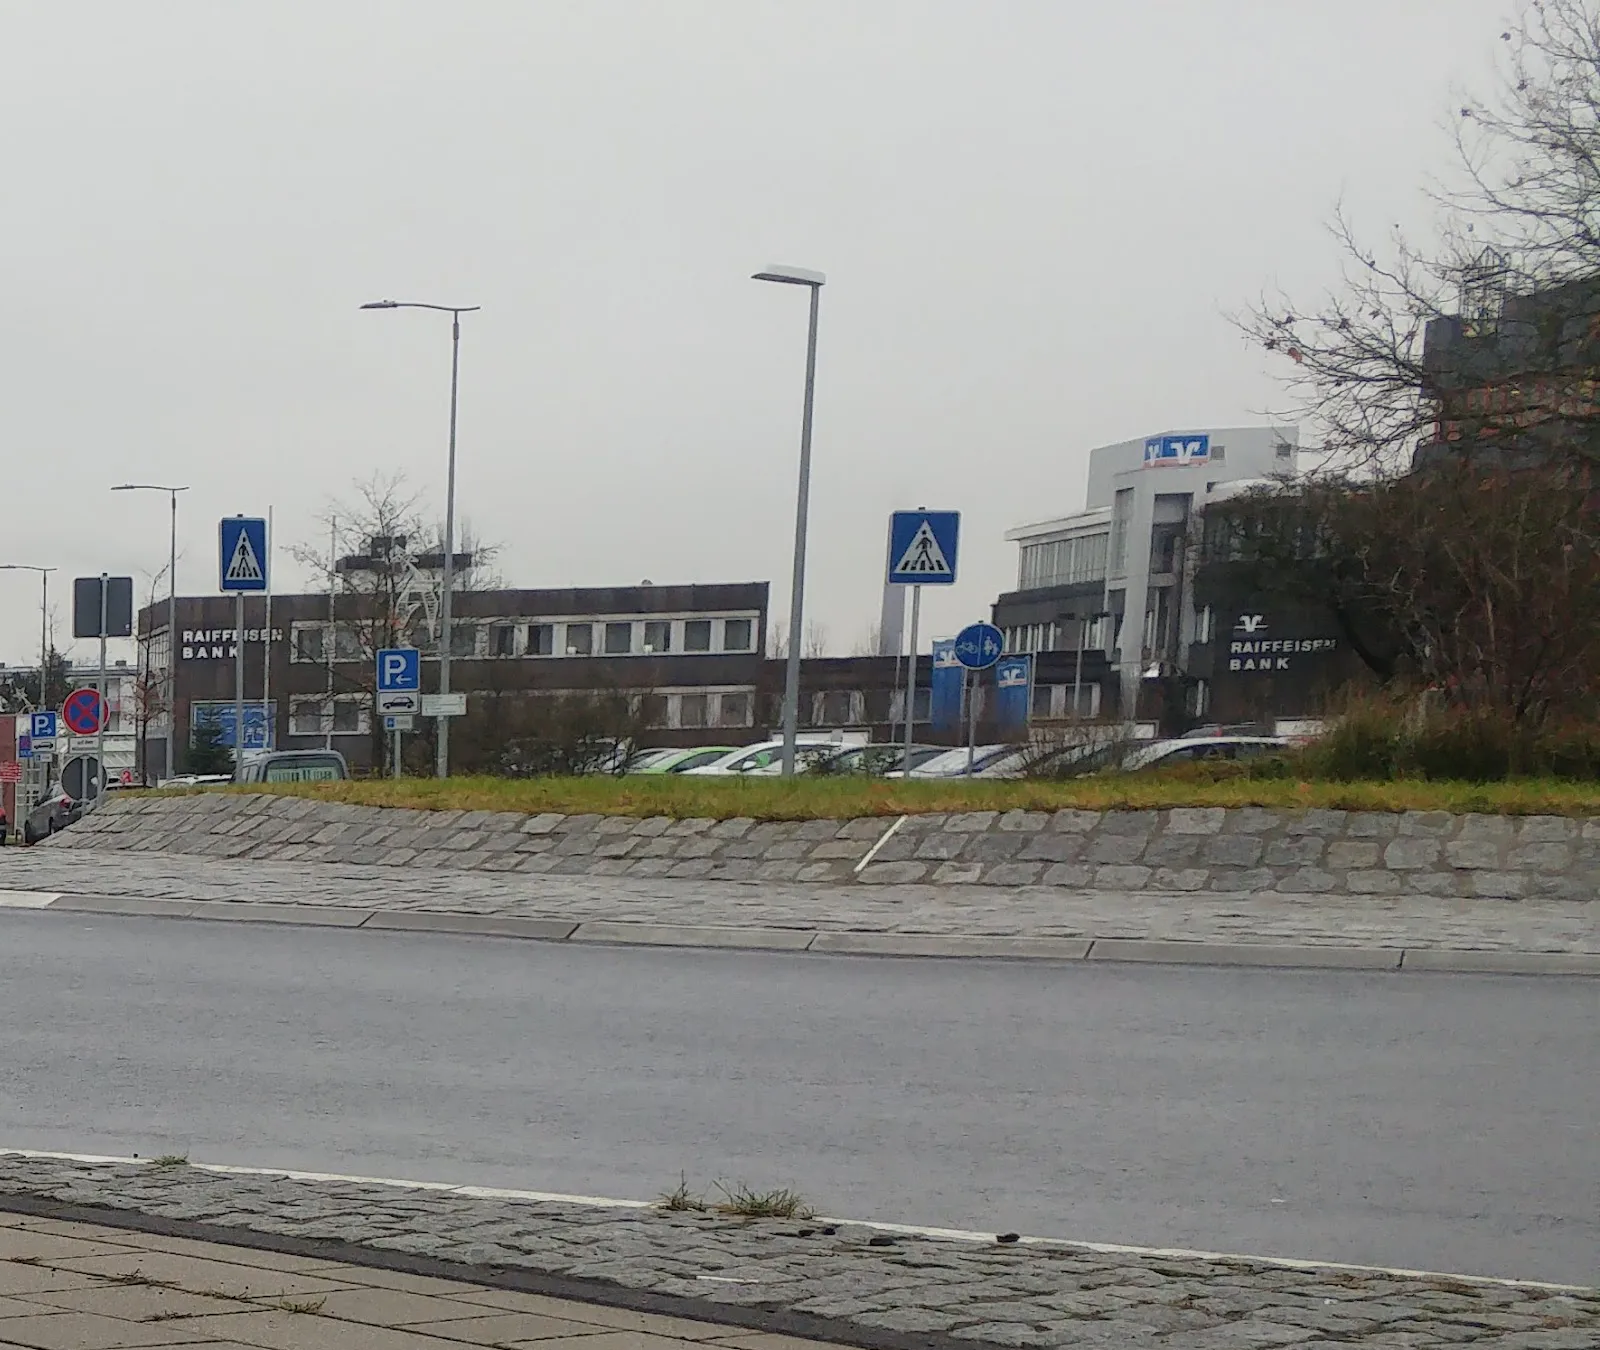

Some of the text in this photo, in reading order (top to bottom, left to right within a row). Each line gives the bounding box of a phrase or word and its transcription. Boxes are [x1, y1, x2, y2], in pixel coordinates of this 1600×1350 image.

[182, 628, 284, 643] RAIFFEISEN
[182, 645, 238, 659] BANK
[384, 654, 407, 686] P
[1229, 658, 1289, 670] BANK
[34, 715, 50, 735] P
